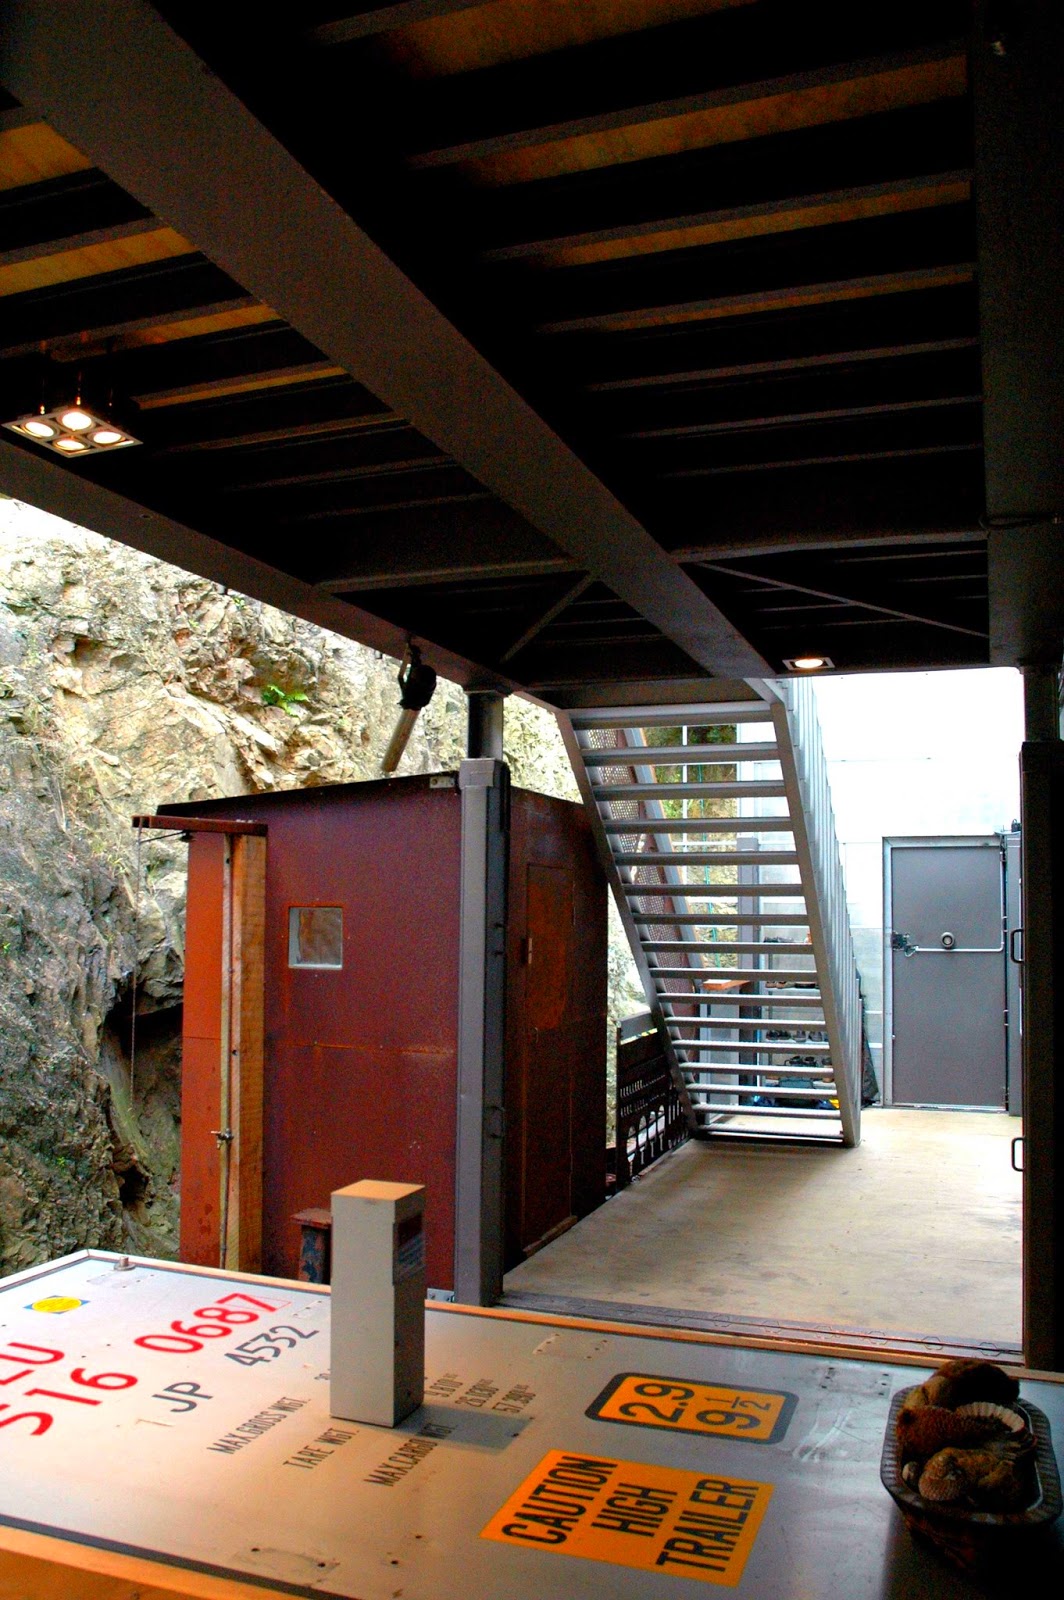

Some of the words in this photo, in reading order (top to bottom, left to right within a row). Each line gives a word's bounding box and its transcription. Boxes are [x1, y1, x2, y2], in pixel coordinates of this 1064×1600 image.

[151, 1381, 213, 1413] JP
[223, 1325, 320, 1367] 4532
[619, 1382, 695, 1423] 2.9
[282, 1445, 335, 1469] TARE
[501, 1455, 618, 1546] CAUTION
[591, 1482, 678, 1537] HIGH
[655, 1478, 760, 1573] TRAILER
